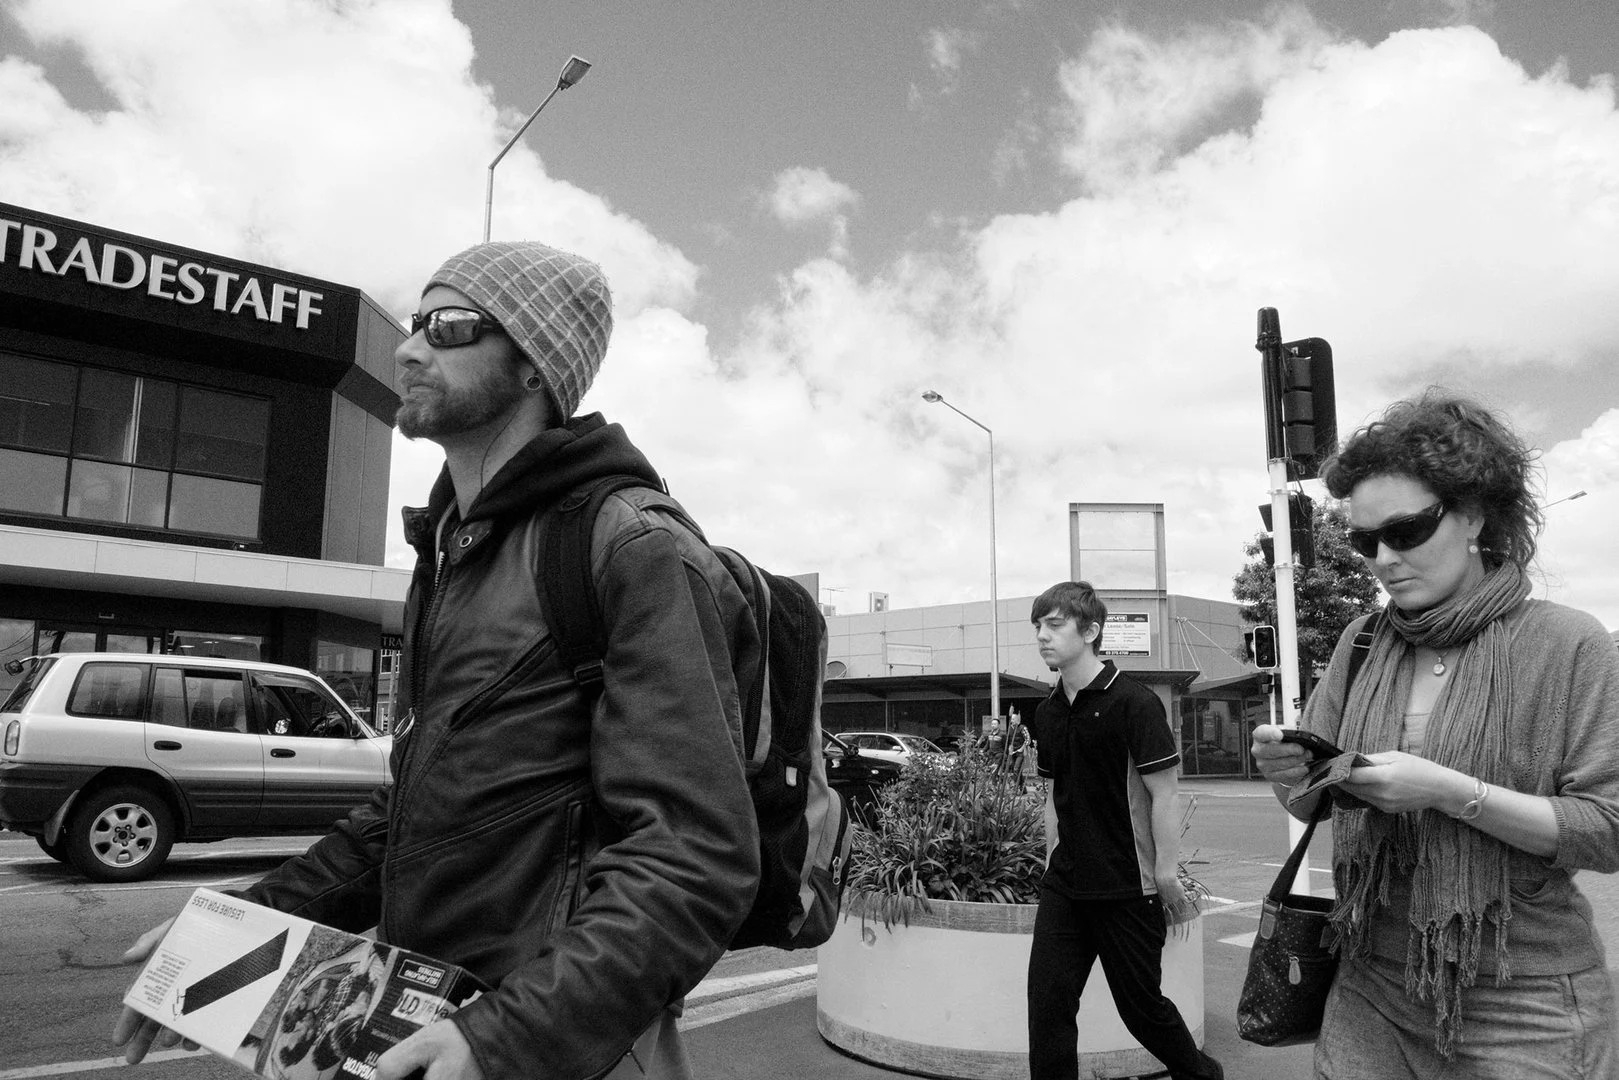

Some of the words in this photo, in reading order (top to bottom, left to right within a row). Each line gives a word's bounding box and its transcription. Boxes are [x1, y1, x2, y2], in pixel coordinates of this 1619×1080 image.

[0, 218, 324, 329] TRADESTAFF
[191, 896, 209, 910] LESS
[207, 900, 221, 913] FOR
[219, 904, 246, 922] LEISURE
[342, 1056, 377, 1080] VIGATOR
